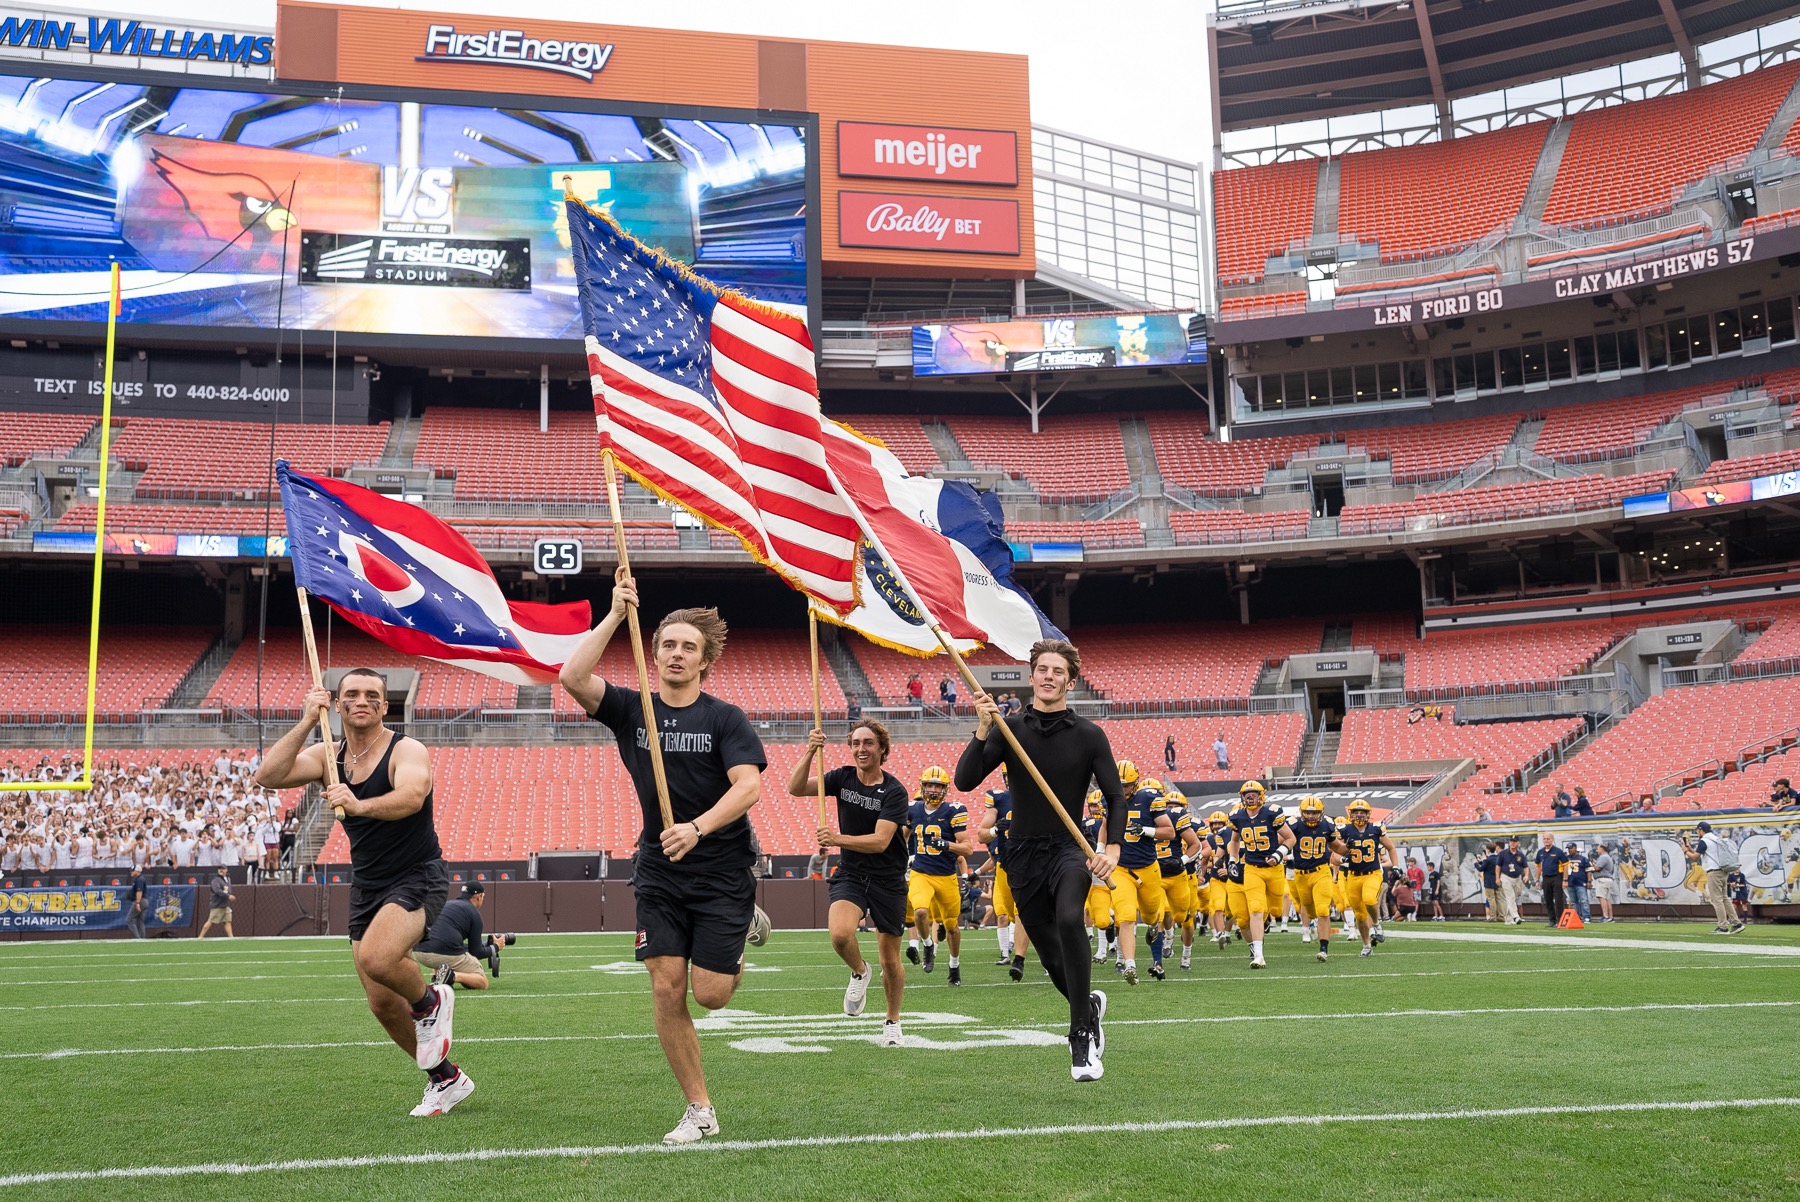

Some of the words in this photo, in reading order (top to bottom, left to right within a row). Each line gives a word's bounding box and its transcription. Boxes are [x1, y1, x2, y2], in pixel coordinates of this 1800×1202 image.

[425, 24, 614, 73] FirstEnergy
[874, 132, 982, 175] meijer
[382, 165, 454, 219] VS
[866, 203, 951, 241] Bally
[954, 218, 982, 235] BET
[378, 239, 507, 271] FirstEnergy
[375, 268, 448, 282] STADIUM
[1555, 273, 1601, 299] CLAY
[1605, 246, 1719, 291] MATTHEWS
[1726, 237, 1755, 264] 57
[1374, 304, 1412, 326] LEN
[1421, 294, 1471, 321] FORD
[1476, 288, 1503, 313] 80
[1043, 319, 1076, 346] VS
[34, 378, 77, 394] TEXT
[153, 383, 177, 398] TO
[186, 384, 290, 403] 440-824-6000
[1769, 472, 1797, 496] VS
[195, 535, 221, 555] VS
[542, 544, 575, 569] 25
[964, 571, 989, 586] ROGRESS
[876, 573, 923, 619] CLEVELAN
[664, 731, 712, 753] IGNATIUS
[840, 788, 882, 811] IGNATIUS
[1198, 790, 1413, 811] PRGRESSIVE
[915, 824, 943, 855] 13
[1241, 826, 1271, 852] 95
[1299, 836, 1327, 859] 90
[1350, 838, 1376, 863] 53
[14, 916, 86, 926] CHAMPIONS
[1560, 911, 1569, 927] G
